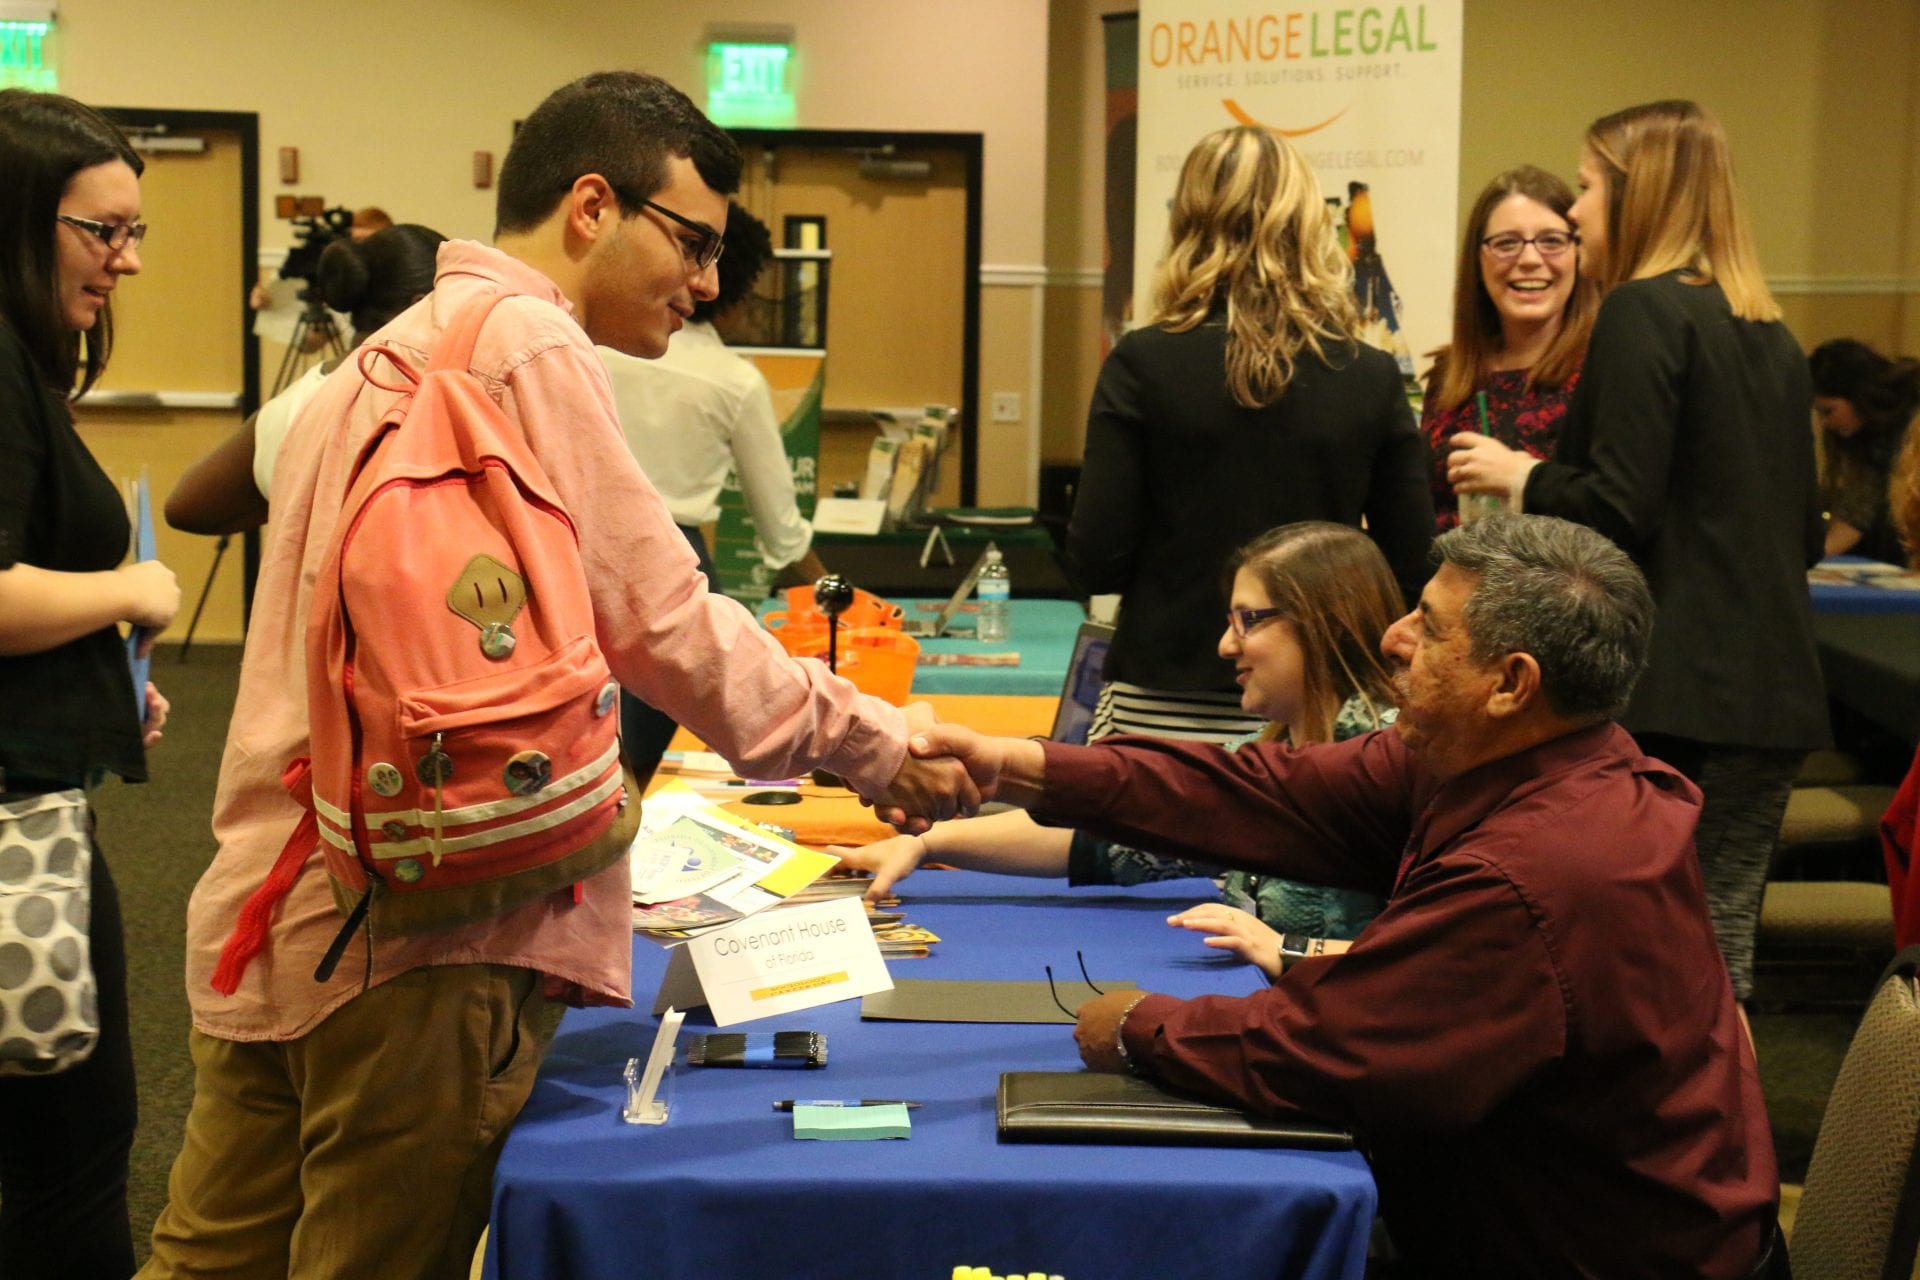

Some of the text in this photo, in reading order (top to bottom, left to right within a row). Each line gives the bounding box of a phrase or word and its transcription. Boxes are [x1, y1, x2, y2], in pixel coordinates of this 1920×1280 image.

[1150, 4, 1438, 68] ORANGE LEGAL
[722, 48, 788, 94] EXIT
[714, 918, 846, 956] Covenant House
[765, 955, 776, 969] of
